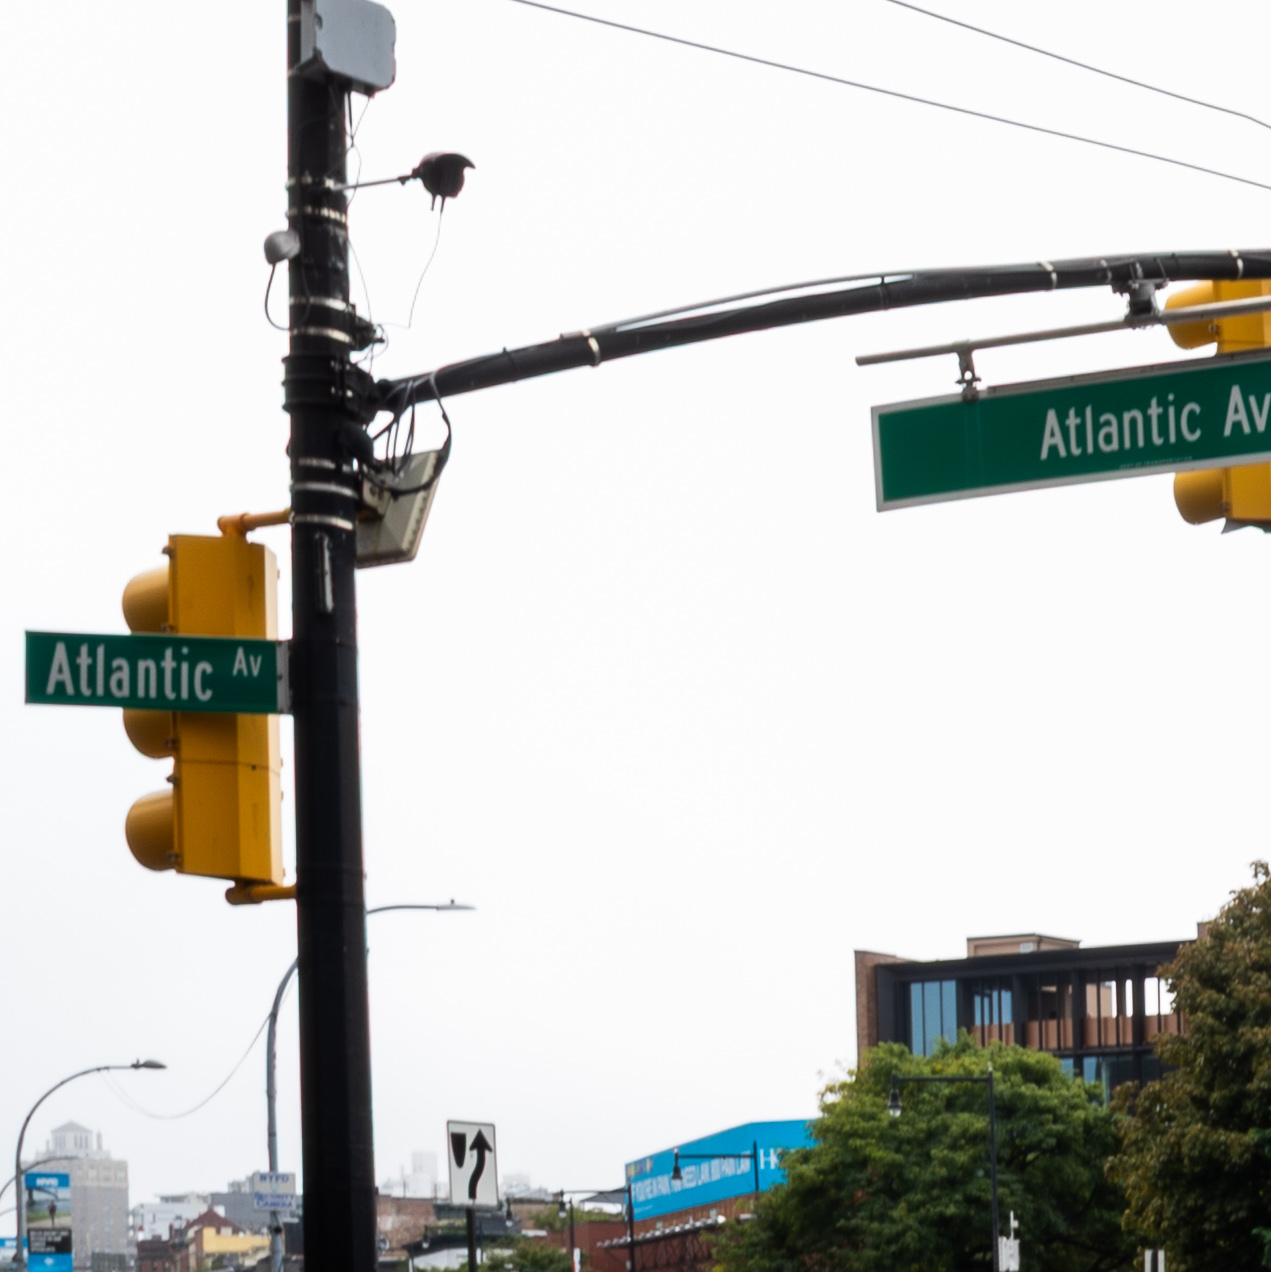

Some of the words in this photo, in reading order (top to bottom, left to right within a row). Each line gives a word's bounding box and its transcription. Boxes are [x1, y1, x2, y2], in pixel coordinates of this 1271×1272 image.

[1039, 393, 1201, 460] Atlantic
[1223, 385, 1271, 437] Av
[46, 641, 213, 701] Atlantic
[233, 646, 262, 677] Av
